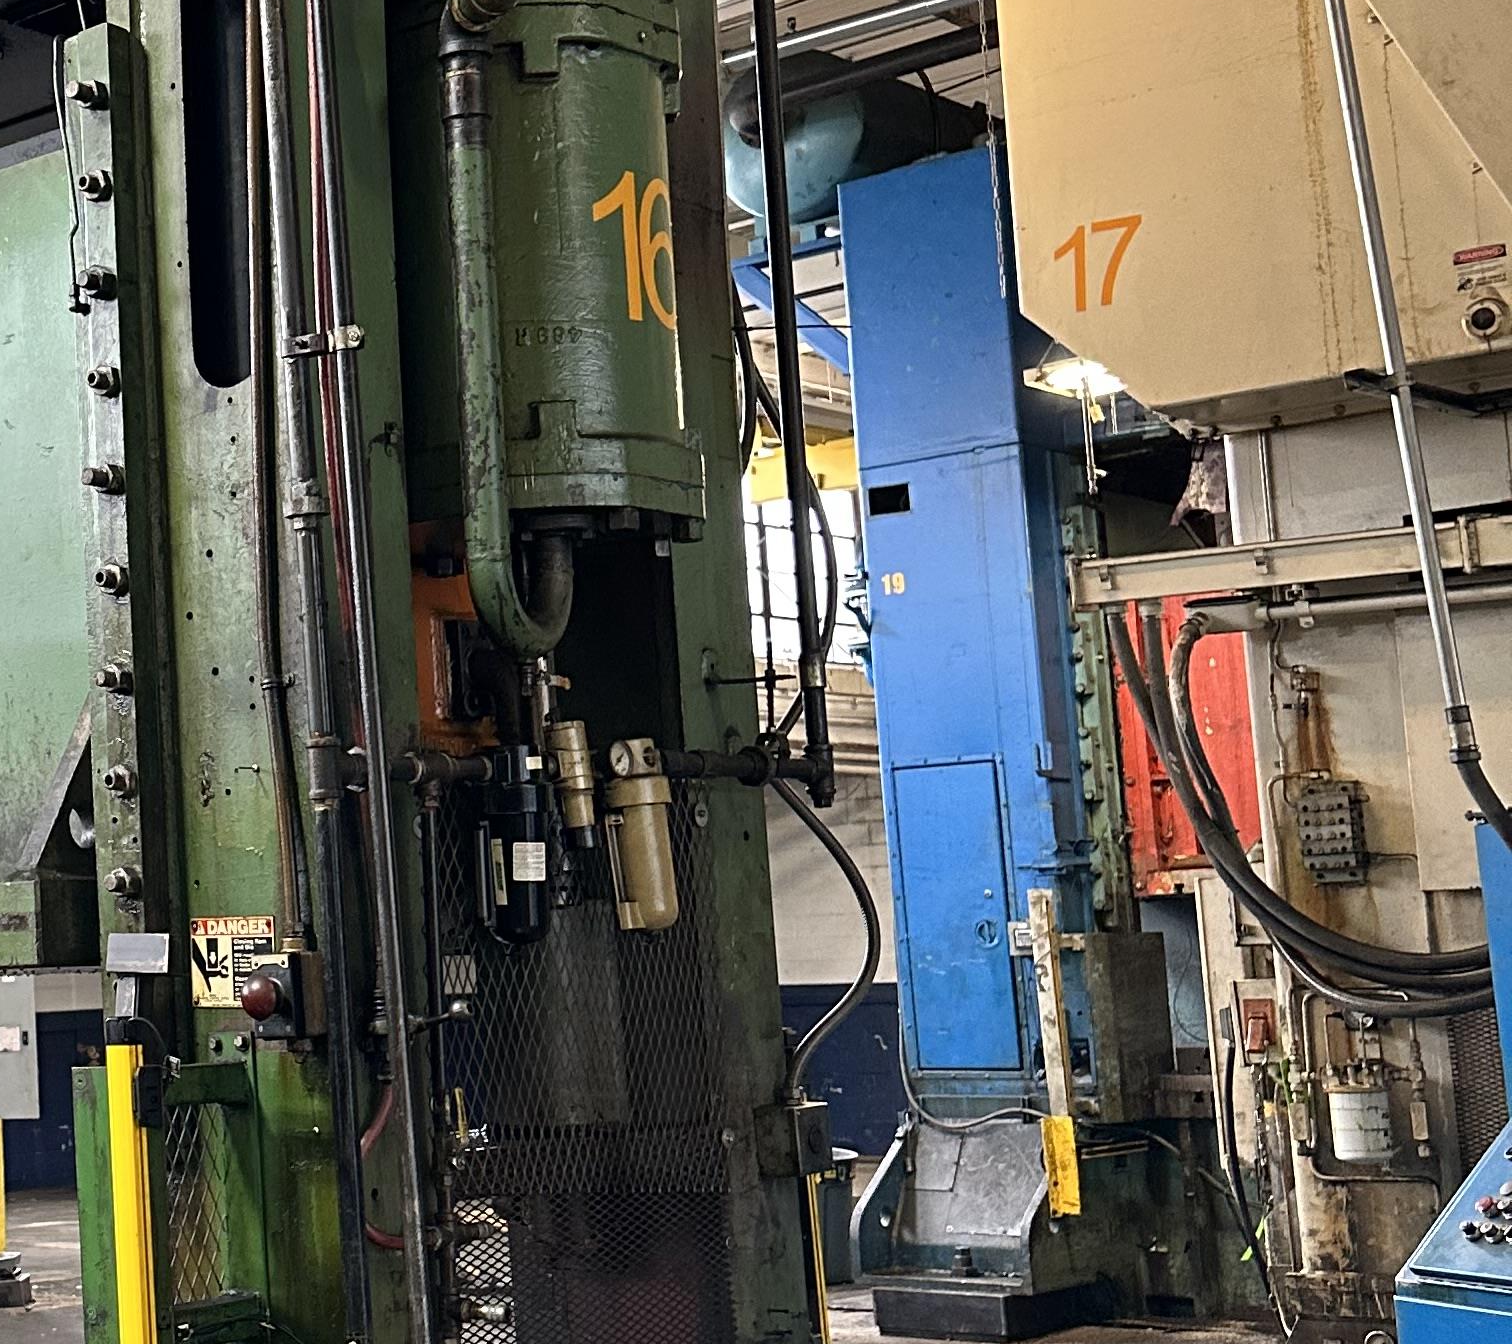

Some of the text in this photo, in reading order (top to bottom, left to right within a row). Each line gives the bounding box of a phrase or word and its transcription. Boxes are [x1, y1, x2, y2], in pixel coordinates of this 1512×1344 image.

[592, 170, 676, 330] 16
[1054, 214, 1142, 312] 17
[881, 572, 905, 595] 19
[207, 919, 269, 935] DANGER
